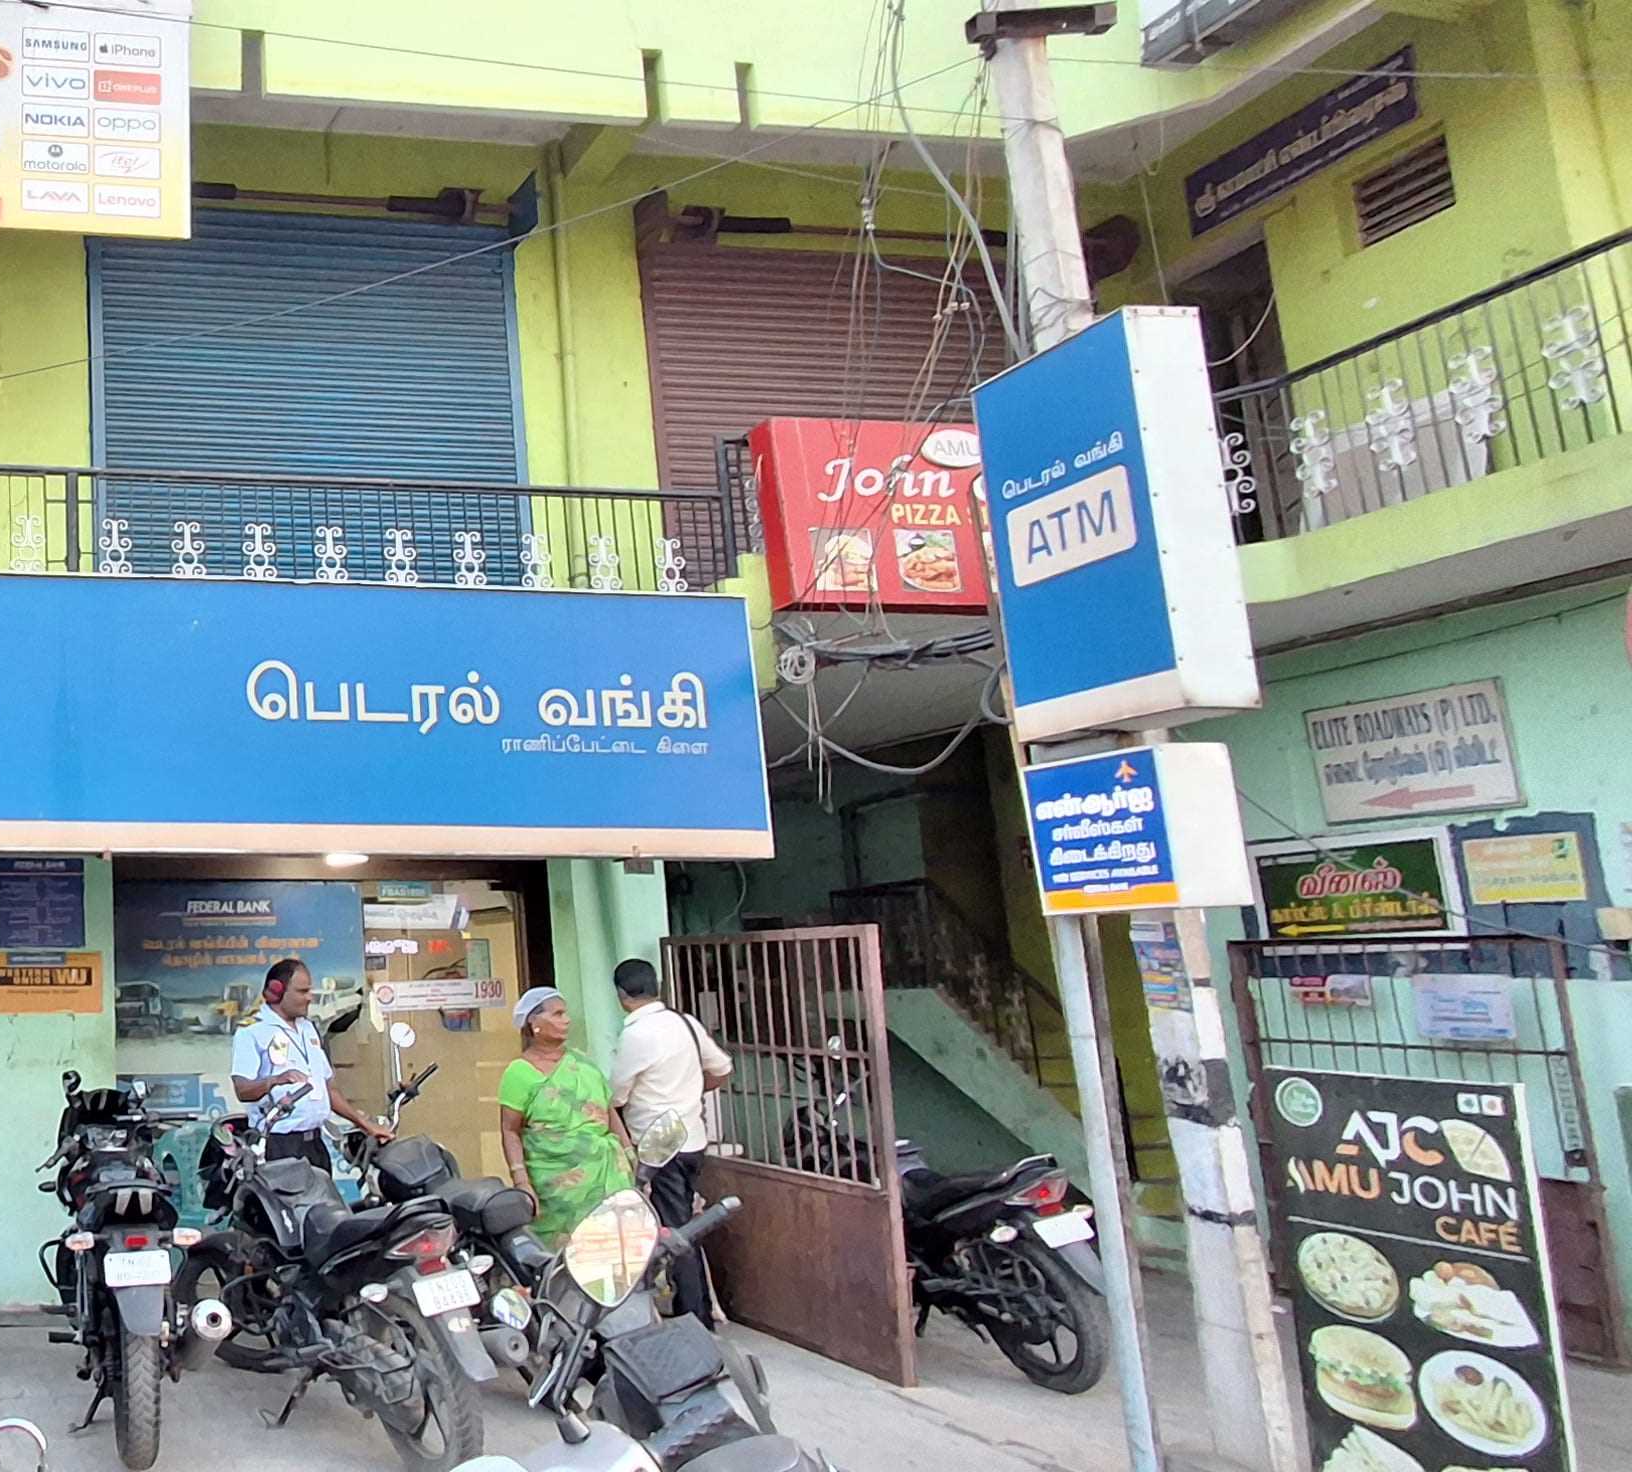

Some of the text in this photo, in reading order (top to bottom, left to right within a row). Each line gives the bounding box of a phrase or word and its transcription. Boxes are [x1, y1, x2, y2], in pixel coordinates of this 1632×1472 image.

[24, 37, 88, 52] SAMSUNG
[110, 43, 156, 58] iPhone
[25, 72, 86, 91] vivo
[24, 112, 86, 128] NOKIA
[97, 116, 156, 137] oppo
[24, 158, 87, 173] motorola
[27, 190, 80, 203] LAVA
[98, 194, 156, 208] Lenovo
[1002, 431, 1124, 500] பெடரல் வங்கி
[817, 454, 956, 502] John
[891, 503, 961, 525] PIZZA
[1027, 490, 1118, 565] ATM
[246, 660, 708, 735] பெடரல் வங்கி
[1314, 717, 1353, 750] ELITE
[1353, 704, 1431, 743] ROADWAYS
[1435, 698, 1456, 736] (P)
[186, 900, 271, 914] FEDERAL BANK
[473, 979, 502, 1001] 1930
[1388, 1171, 1518, 1221] JOHN
[1435, 1215, 1523, 1254] CAFÉ
